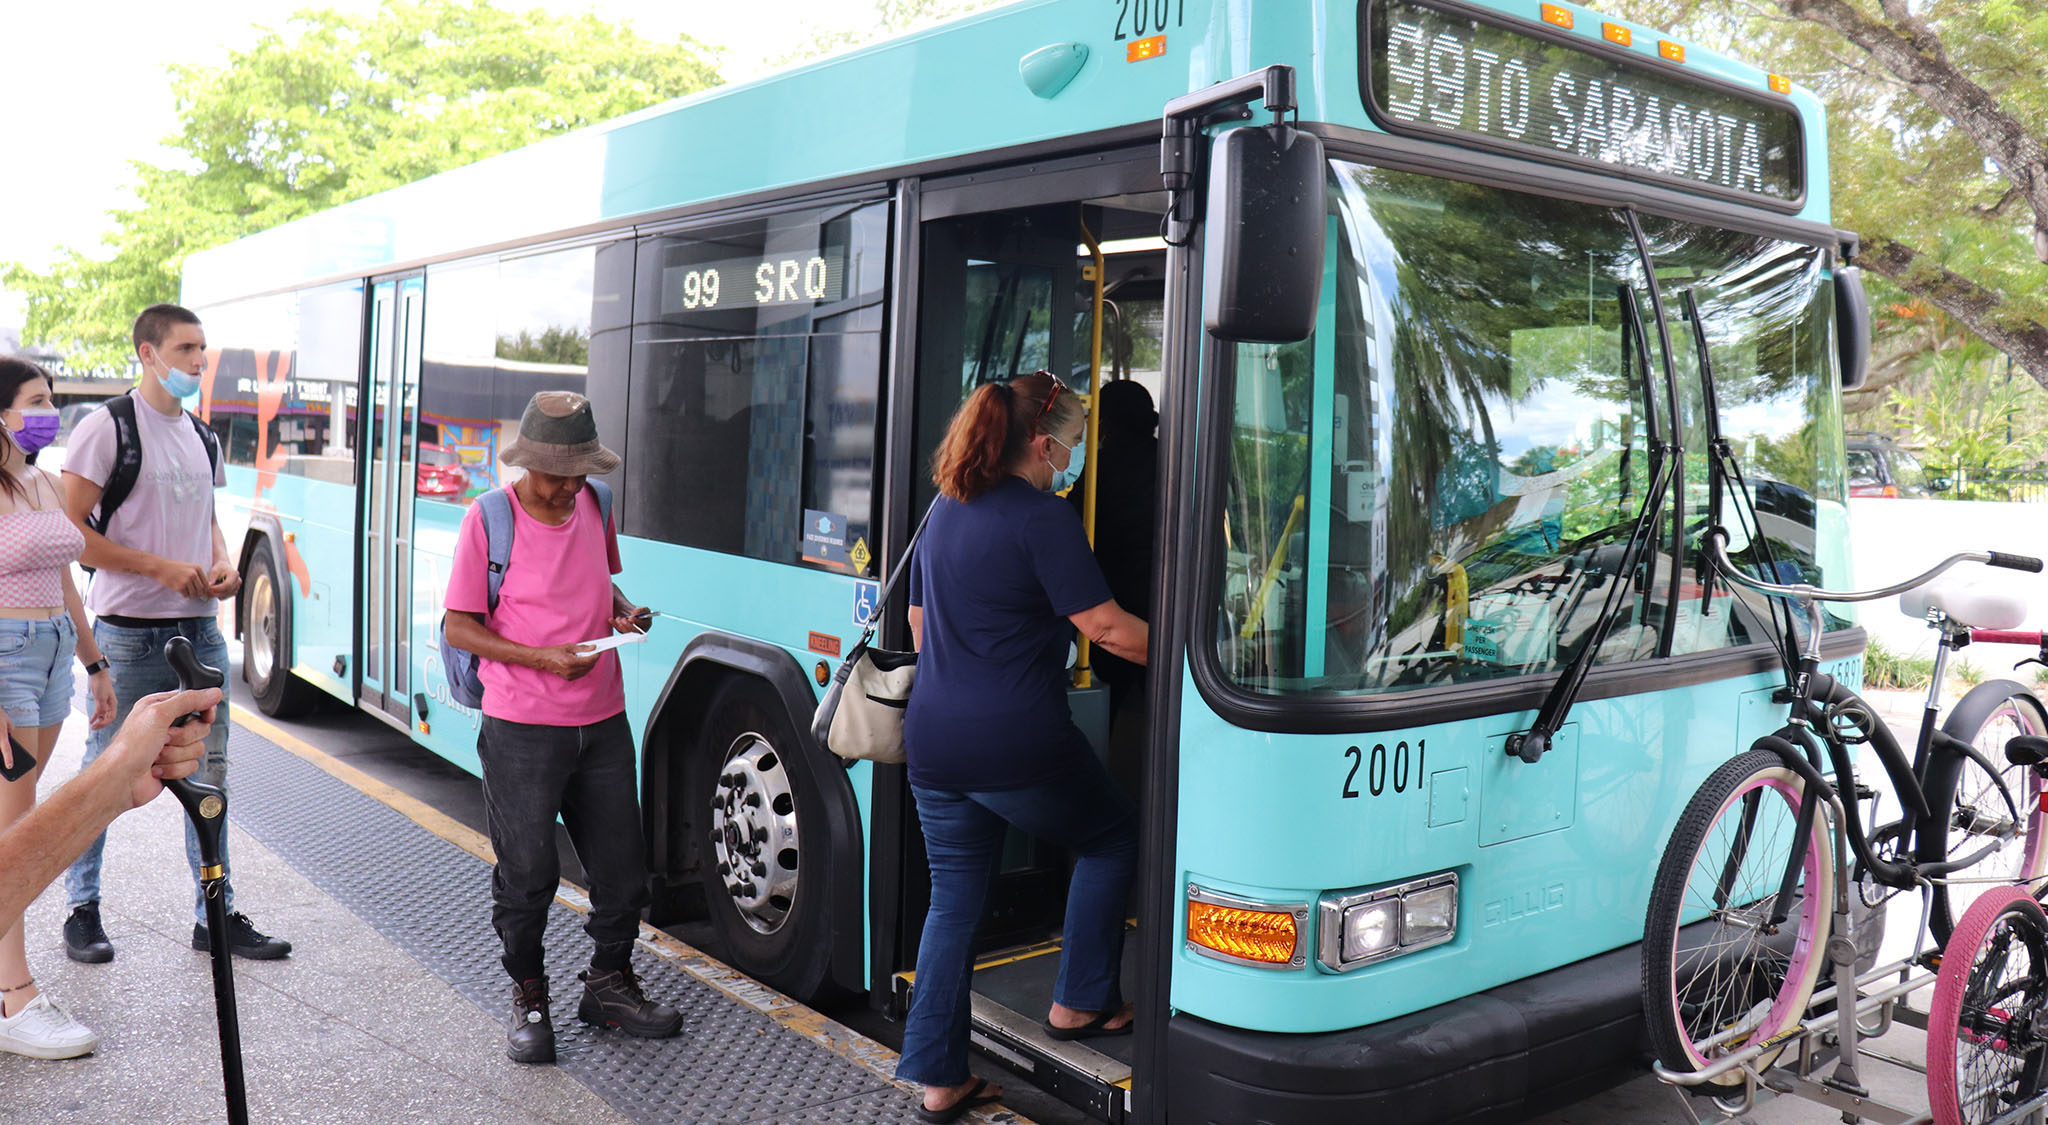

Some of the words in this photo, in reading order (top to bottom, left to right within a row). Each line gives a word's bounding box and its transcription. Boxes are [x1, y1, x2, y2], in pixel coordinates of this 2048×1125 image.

[1114, 0, 1184, 41] 2001
[1387, 22, 1466, 130] 99
[1548, 70, 1762, 193] SARASOTA
[683, 268, 720, 310] 99
[754, 256, 827, 303] SRQ
[1464, 644, 1496, 657] PASSENGER
[1342, 738, 1426, 799] 2001
[1483, 882, 1564, 929] GILLIG
